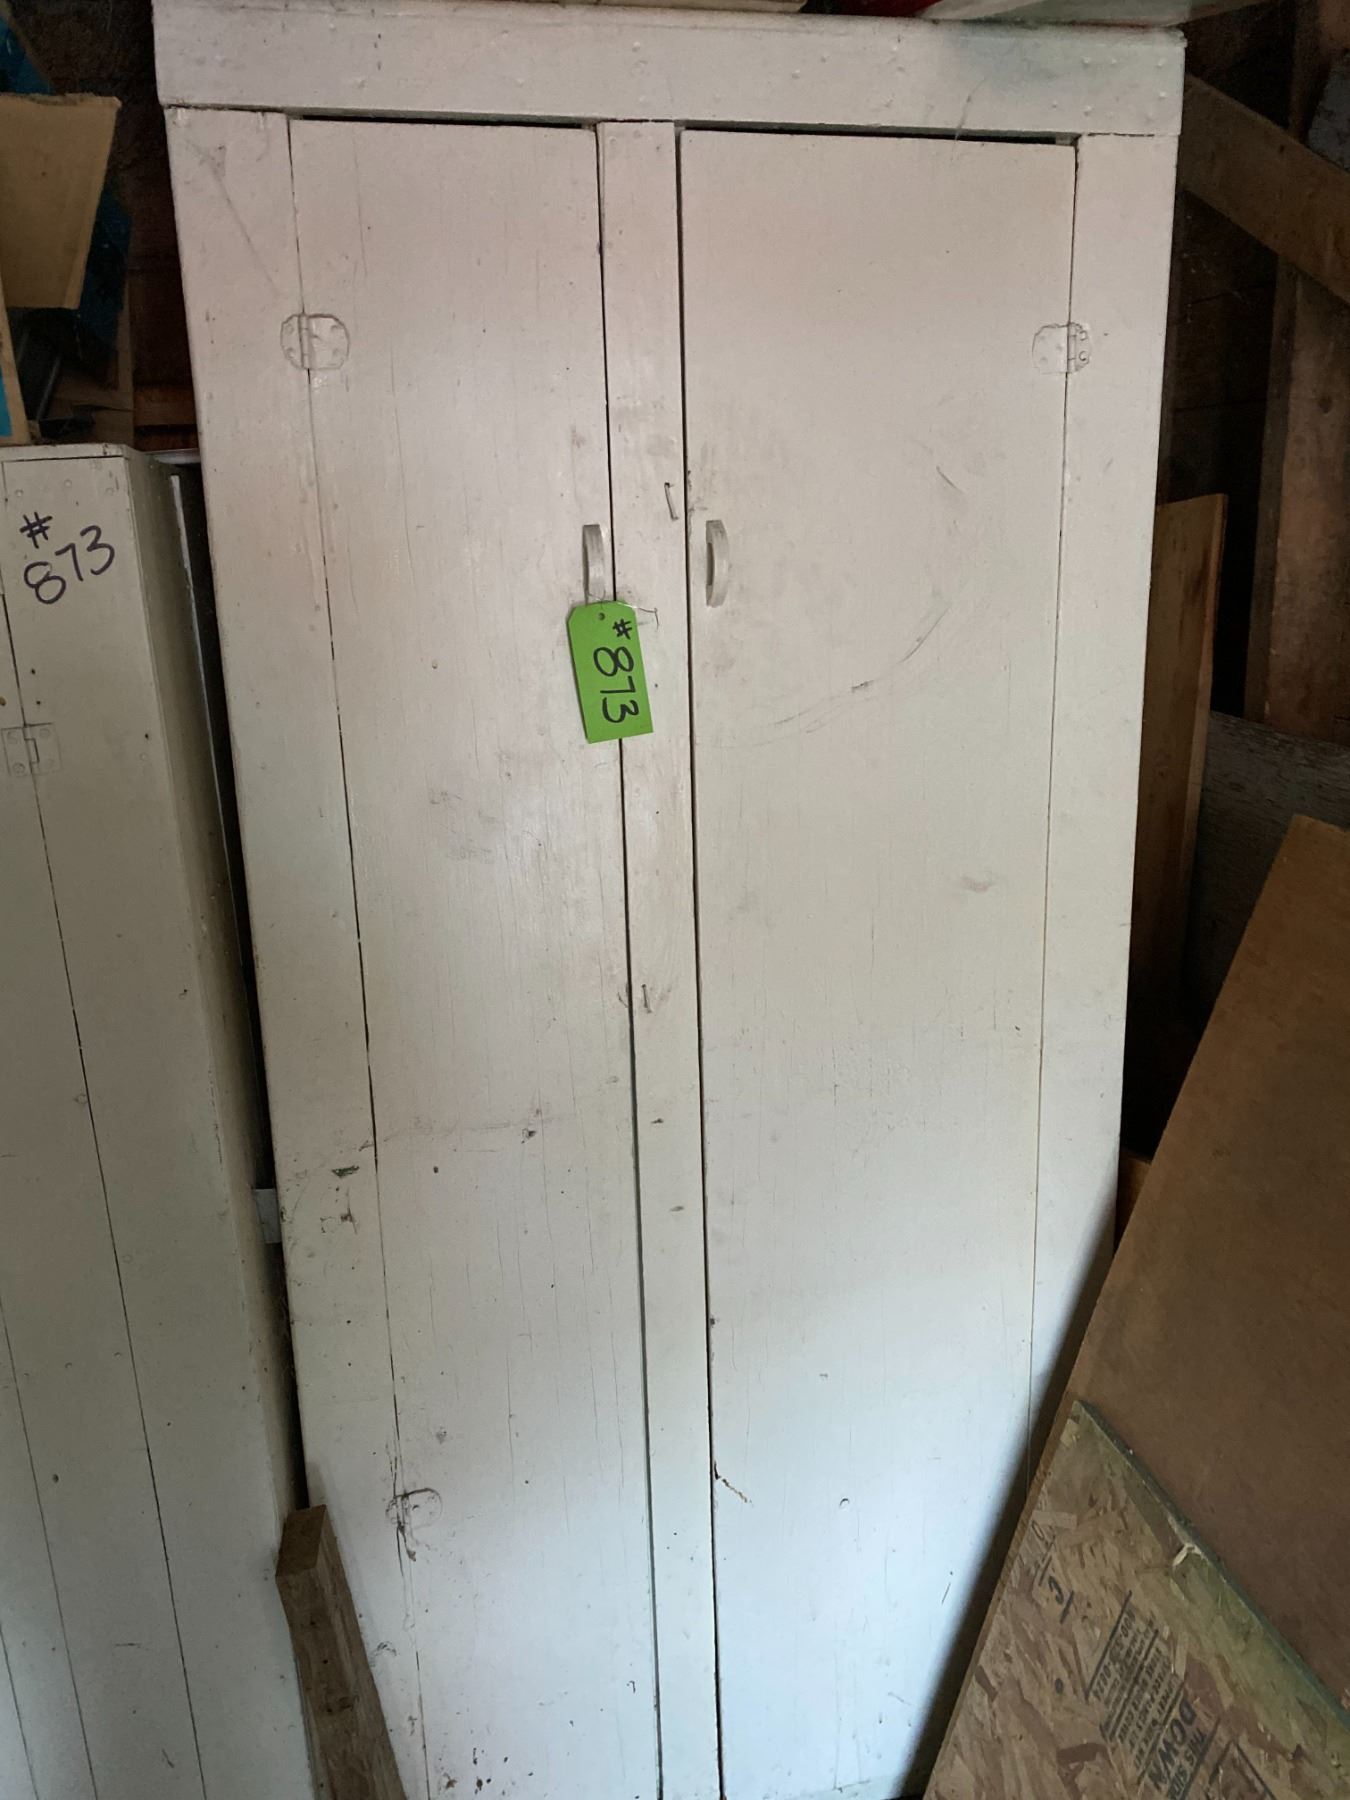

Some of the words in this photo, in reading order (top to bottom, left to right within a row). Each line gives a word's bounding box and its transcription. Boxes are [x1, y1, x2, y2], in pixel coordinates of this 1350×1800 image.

[20, 511, 53, 549] #
[24, 525, 115, 604] 873
[1147, 1697, 1197, 1792] DOWN
[1183, 1727, 1206, 1767] THIS
